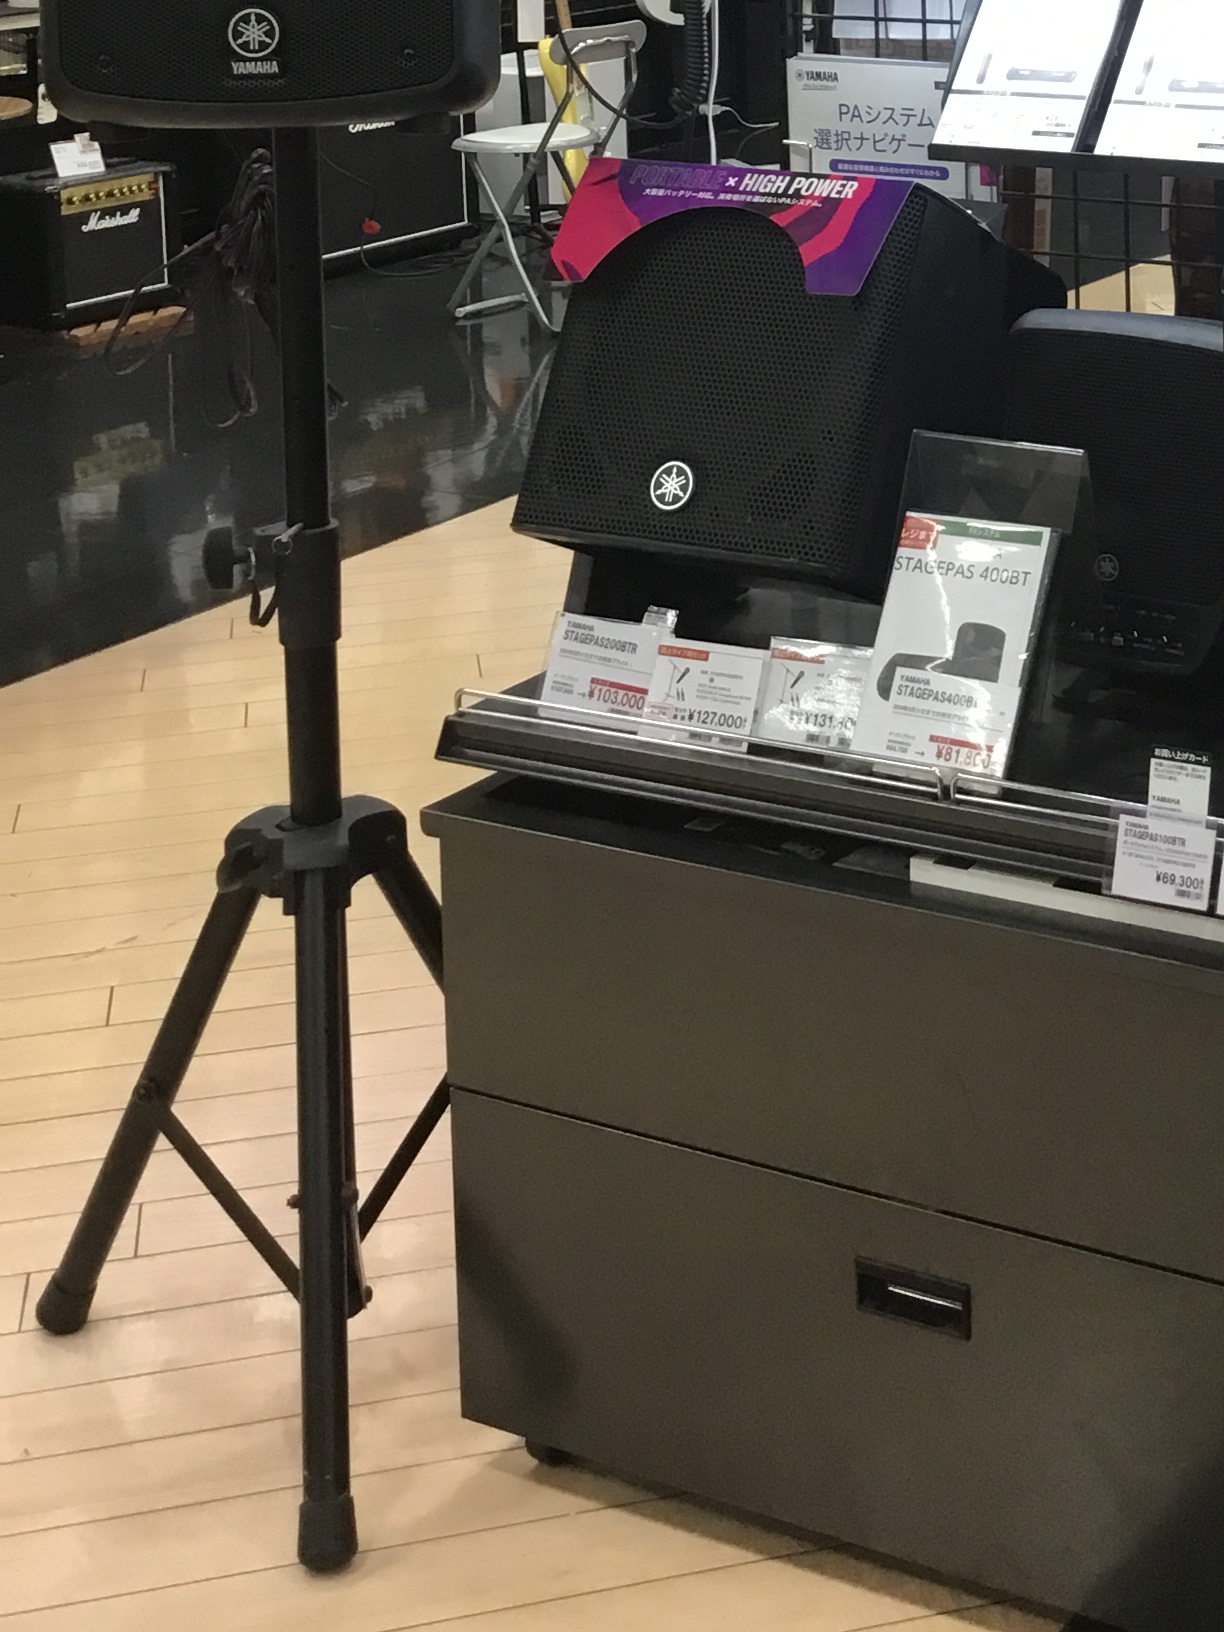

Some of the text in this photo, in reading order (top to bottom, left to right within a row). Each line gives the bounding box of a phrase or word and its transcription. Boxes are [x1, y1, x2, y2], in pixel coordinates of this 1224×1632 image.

[230, 60, 279, 75] YAMAHA
[805, 70, 839, 83] YAMAHA
[838, 103, 936, 129] PAシステム
[629, 164, 729, 190] PORTABLE
[739, 172, 791, 195] HIGH
[789, 175, 860, 200] POWER
[81, 207, 140, 232] Marshall
[893, 555, 1032, 587] STAGEPAS 400BT
[567, 620, 595, 632] YAMAHA
[563, 629, 638, 655] STAGEPAS200BTR
[900, 674, 931, 686] YAMAHA
[587, 683, 646, 711] ¥103,000
[688, 709, 743, 730] ¥127,000
[1155, 870, 1200, 890] ¥69,300
